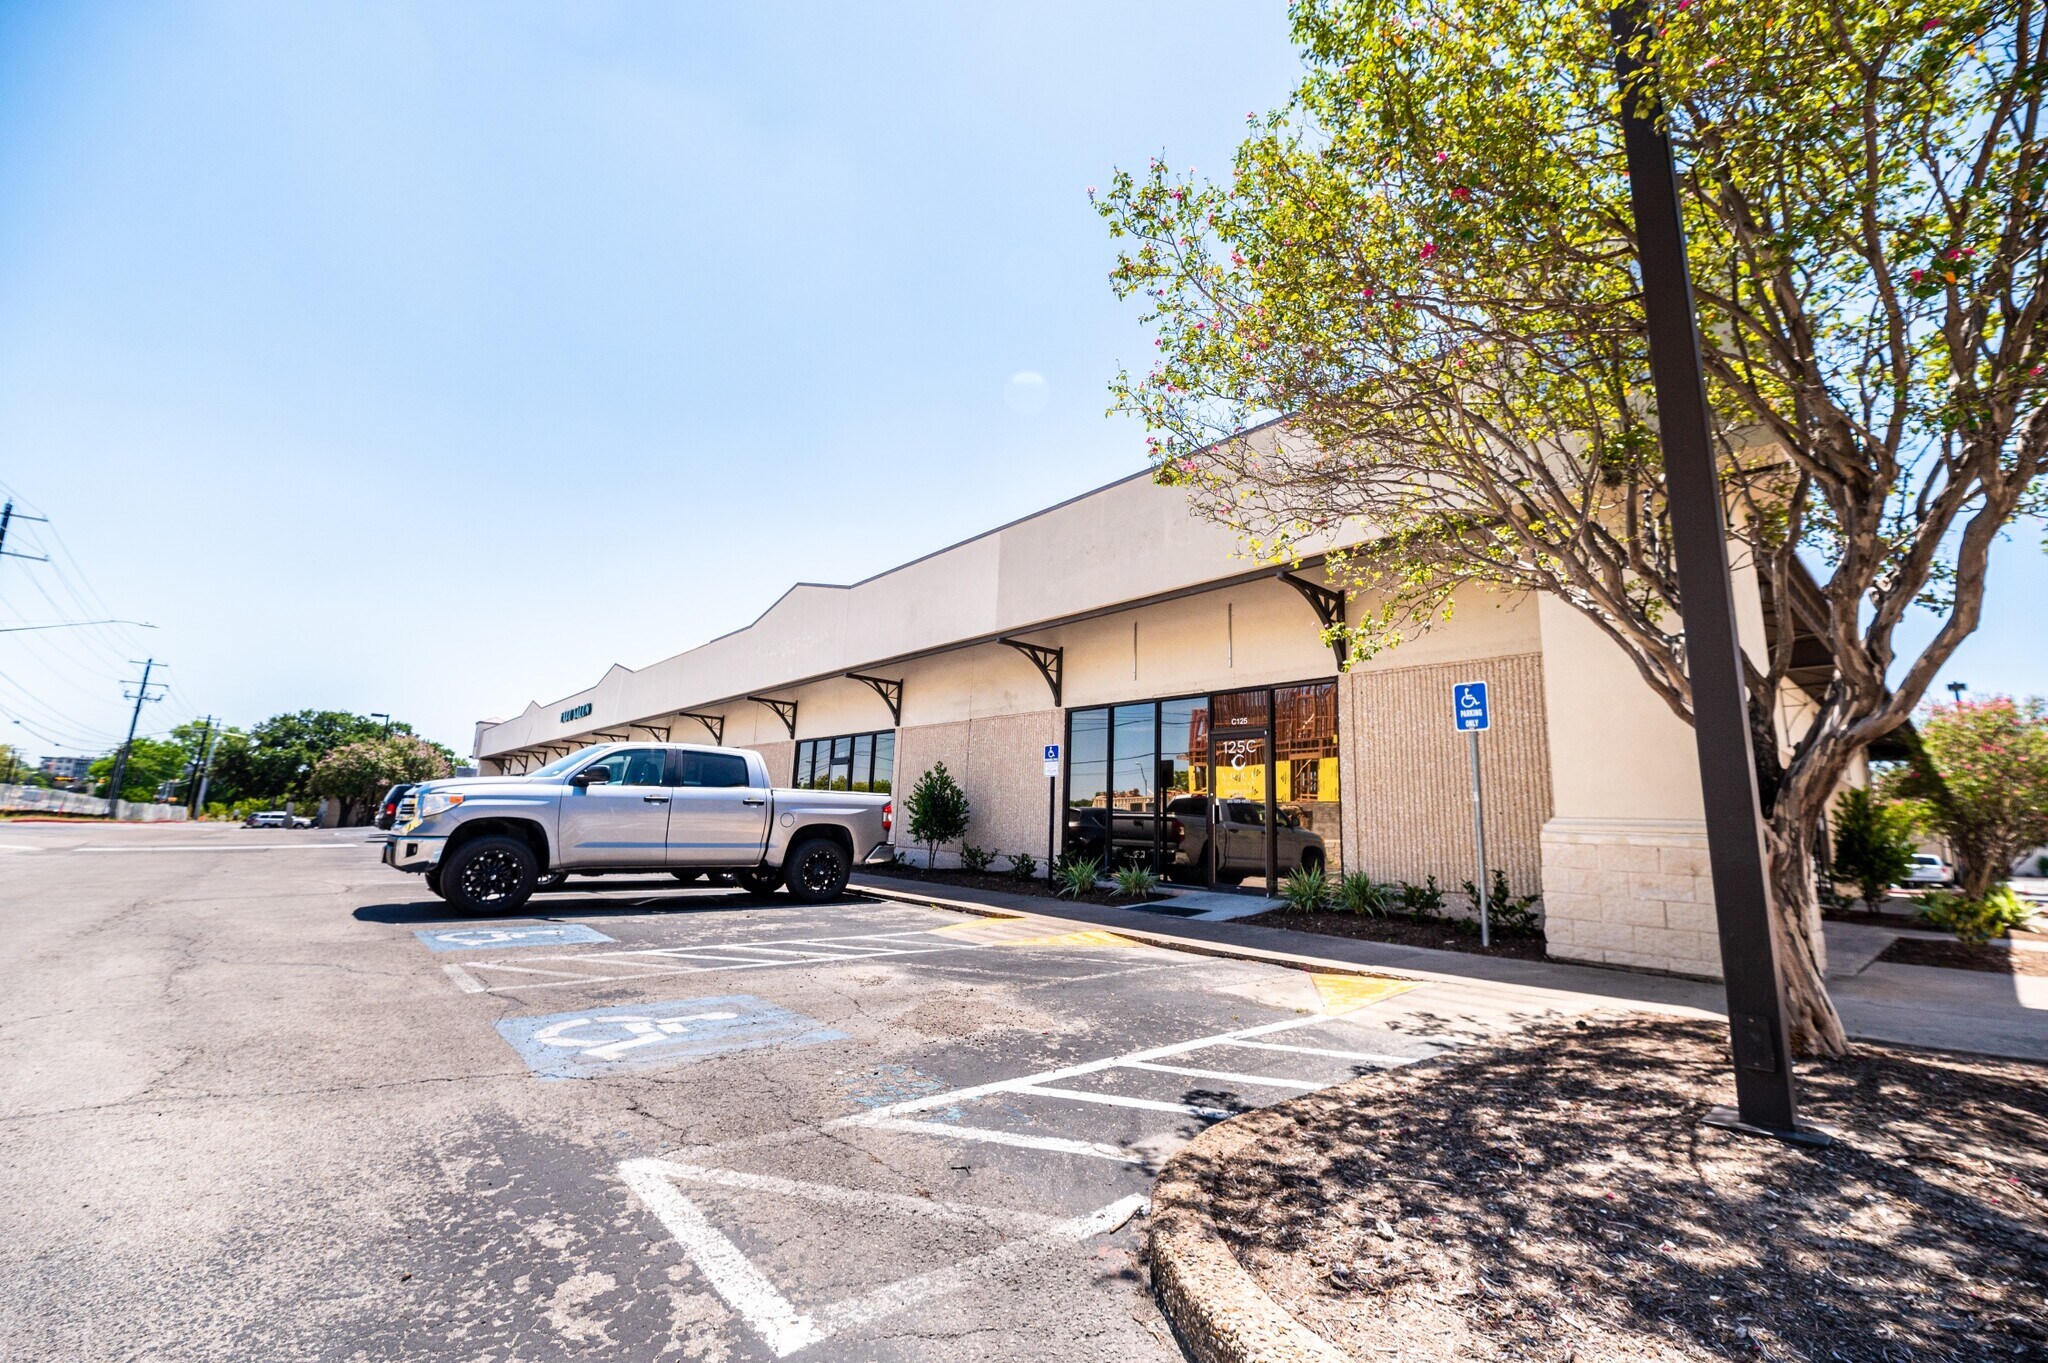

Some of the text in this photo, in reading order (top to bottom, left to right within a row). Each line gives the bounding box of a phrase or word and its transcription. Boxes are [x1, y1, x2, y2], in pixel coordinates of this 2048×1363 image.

[1460, 708, 1483, 718] PARKING
[1231, 717, 1248, 725] C125
[1465, 719, 1479, 728] ONLY
[1222, 739, 1257, 754] 125C
